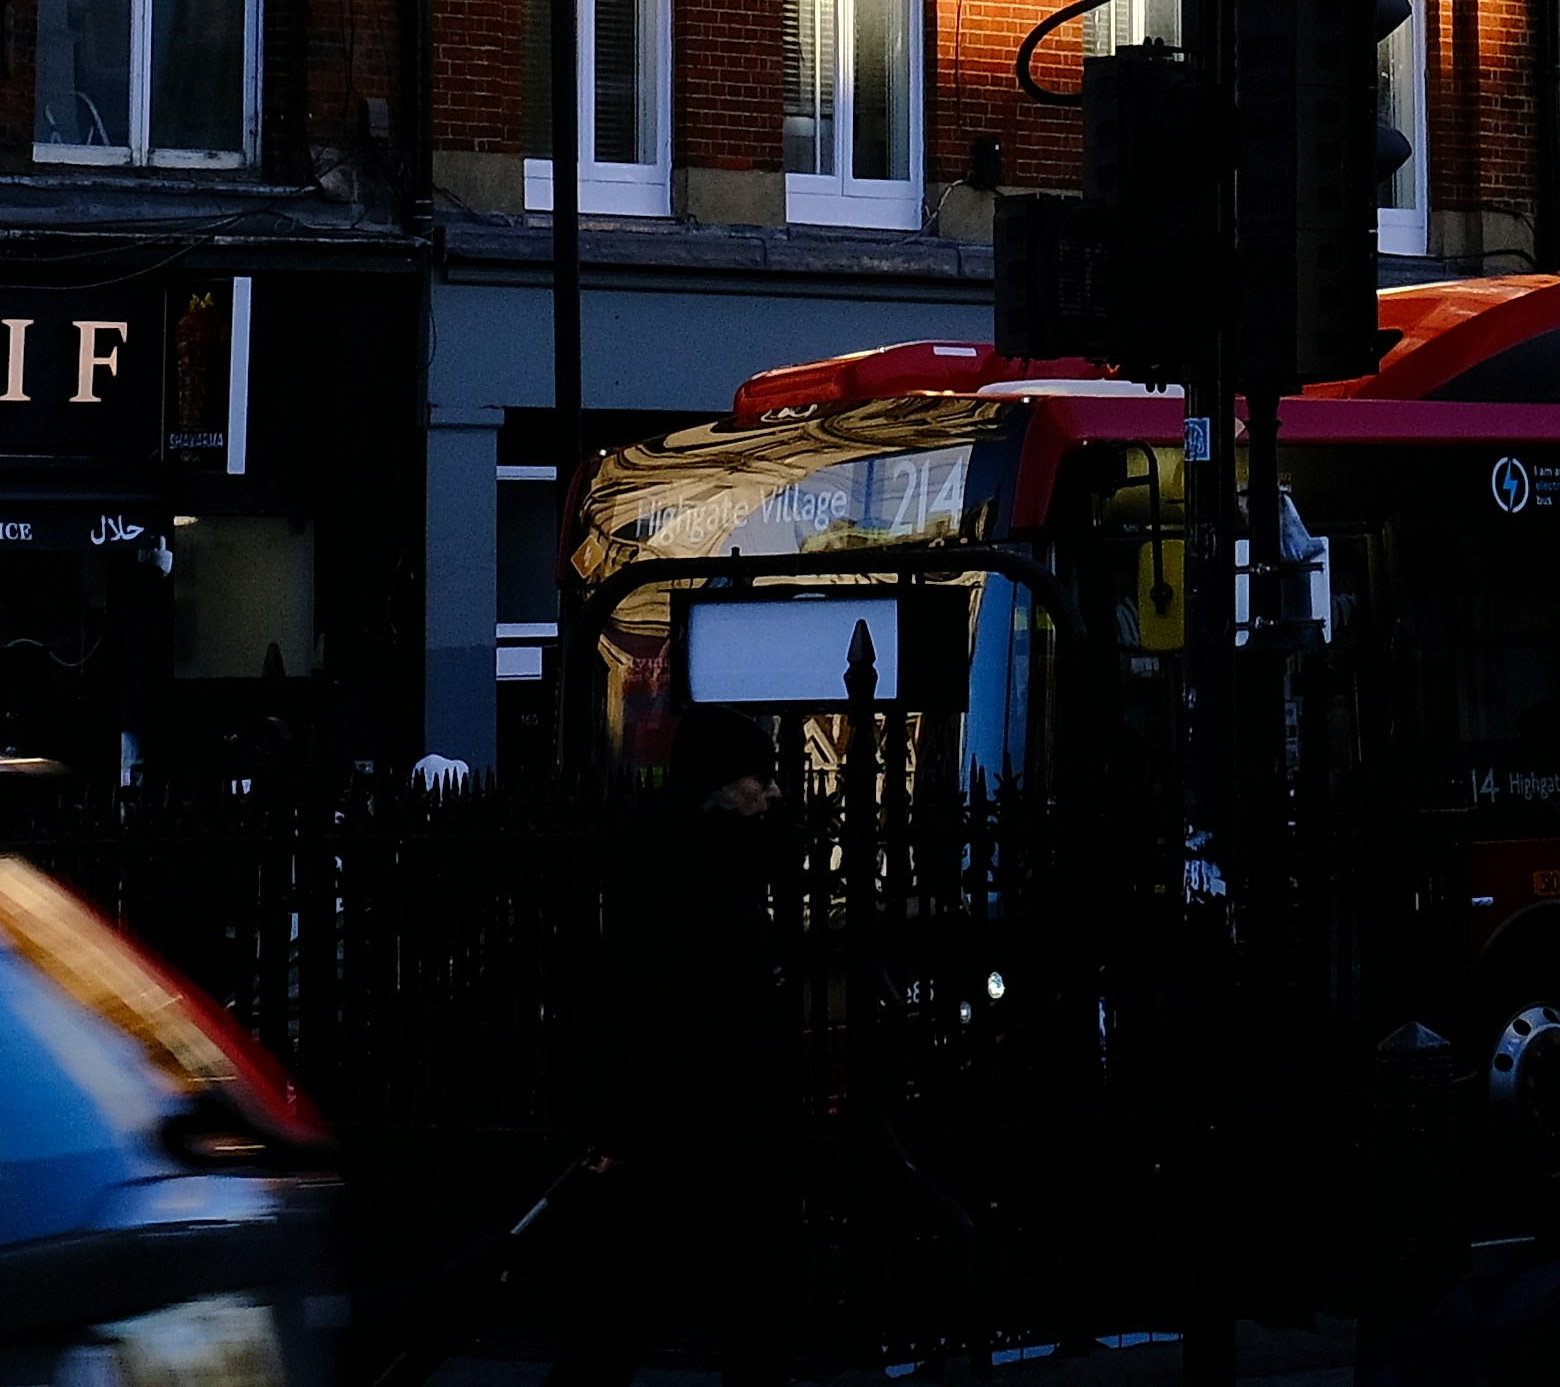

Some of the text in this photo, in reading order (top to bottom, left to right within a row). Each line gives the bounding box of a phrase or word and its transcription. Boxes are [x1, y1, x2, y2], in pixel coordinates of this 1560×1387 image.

[636, 456, 965, 543] Highgate Village 214
[90, 514, 145, 546] حلال
